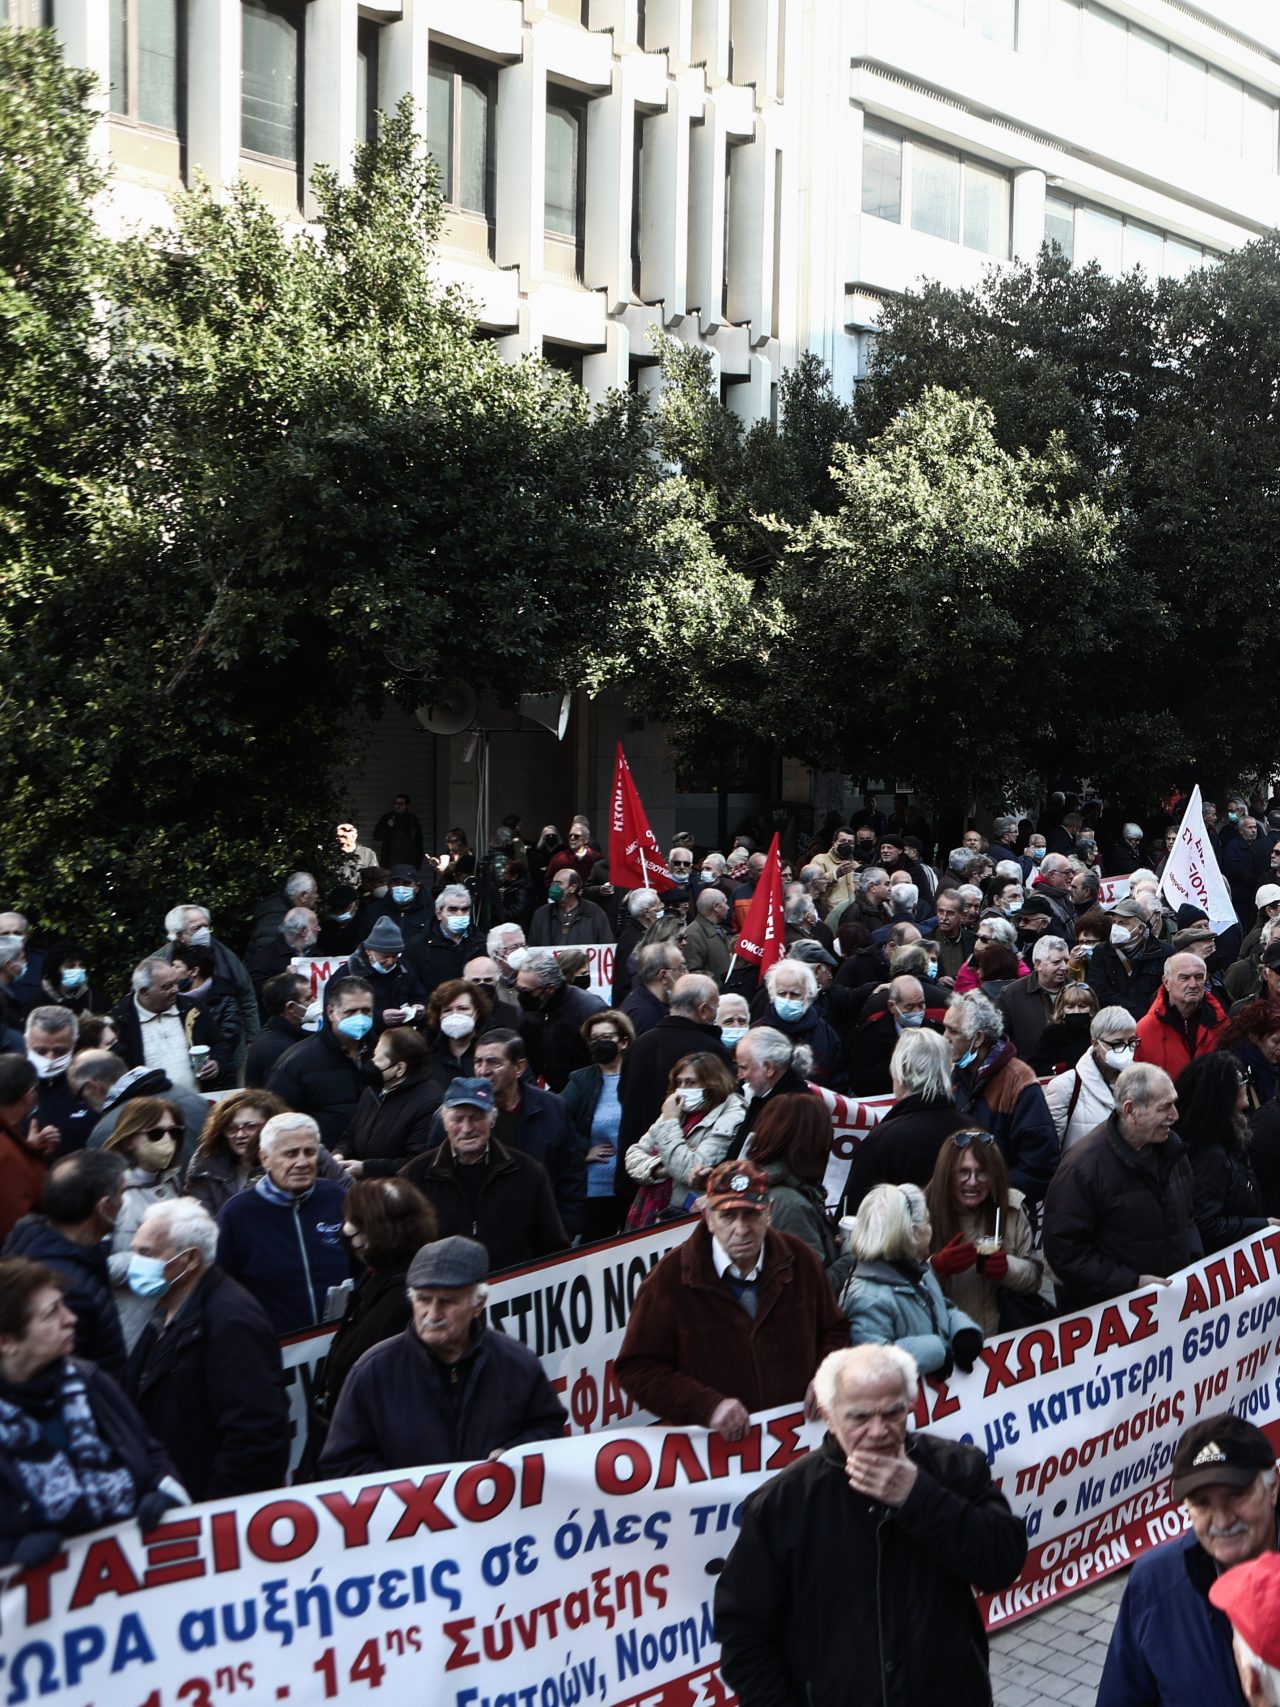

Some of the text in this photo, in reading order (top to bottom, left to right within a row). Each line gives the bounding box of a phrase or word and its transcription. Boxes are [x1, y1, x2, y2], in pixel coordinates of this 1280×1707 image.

[0, 1611, 157, 1707] ΩΡΑ
[178, 1558, 463, 1653] αυξήσεις
[481, 1535, 540, 1587] σε
[554, 1508, 672, 1560] όλες
[984, 1411, 1021, 1467] με
[1028, 1344, 1173, 1434] κατώτερη
[1182, 1312, 1231, 1365] 650
[1, 1452, 546, 1627] ΤΑΞΙΟΥΧΟΙ
[595, 1412, 810, 1496] ΟΛΗΣ
[980, 1291, 1160, 1398] ΧΩΡΑΣ
[442, 1563, 670, 1673] Σύνταξης
[1015, 1389, 1186, 1497] προστασίας
[1193, 1366, 1229, 1416] για
[1236, 1340, 1271, 1383] την
[1074, 1475, 1106, 1517] Να
[1192, 1452, 1226, 1466] adidas
[988, 1535, 1131, 1625] ΔΙΚΗΓΟΡΩΝ
